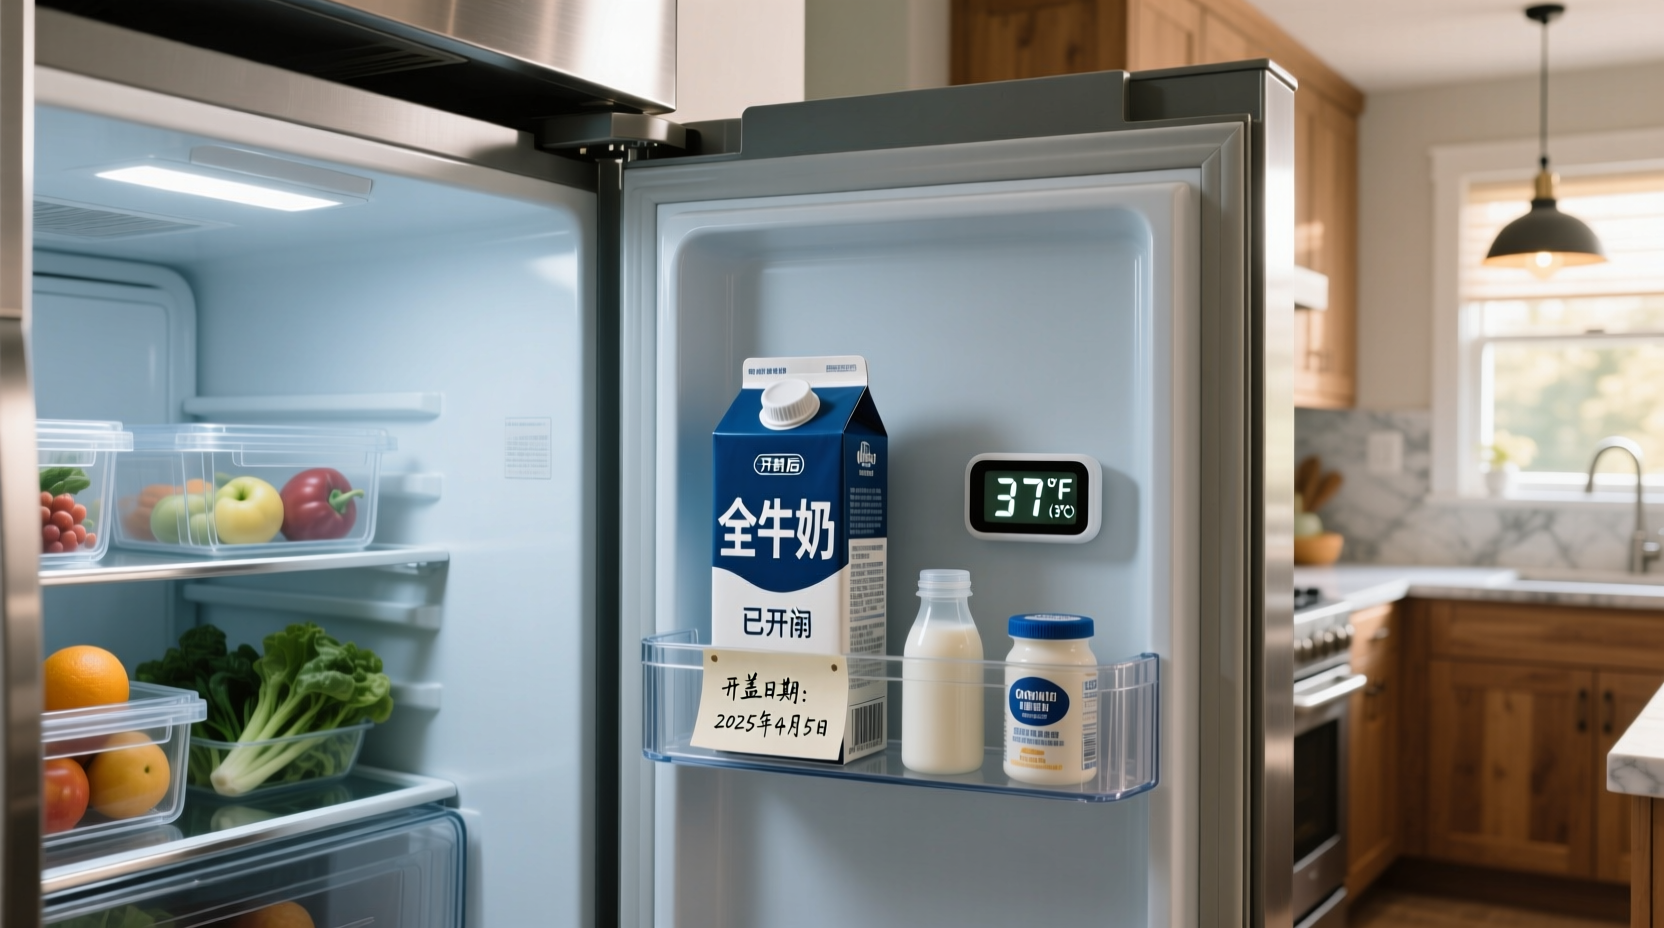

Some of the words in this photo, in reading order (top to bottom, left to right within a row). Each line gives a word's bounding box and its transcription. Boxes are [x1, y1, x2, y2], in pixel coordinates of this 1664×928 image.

[717, 496, 835, 560] 全牛奶
[713, 710, 828, 738] 2025年4月5日
